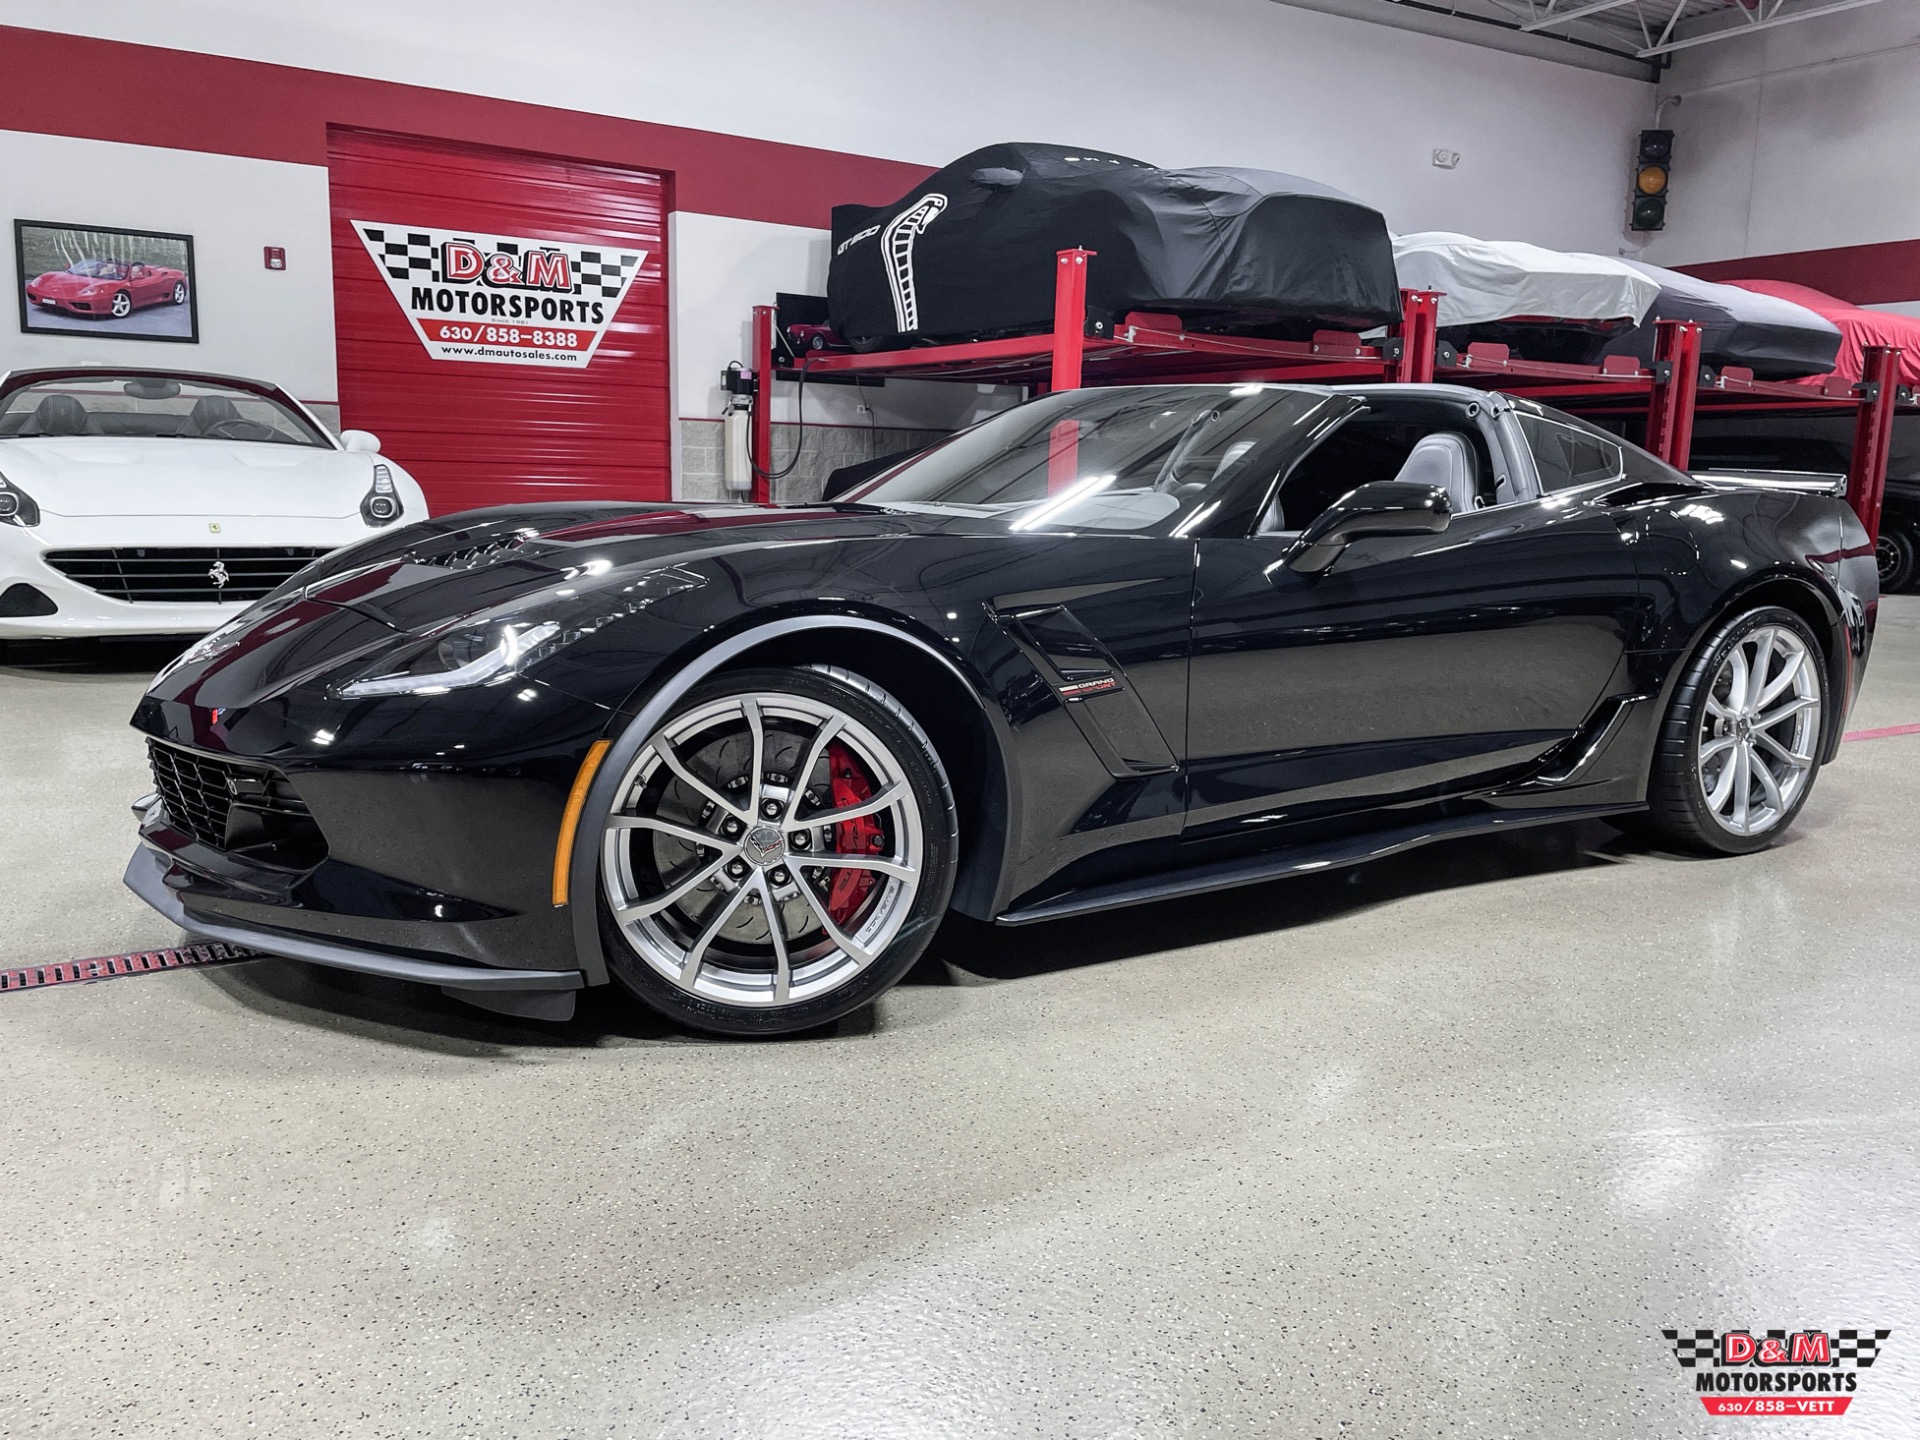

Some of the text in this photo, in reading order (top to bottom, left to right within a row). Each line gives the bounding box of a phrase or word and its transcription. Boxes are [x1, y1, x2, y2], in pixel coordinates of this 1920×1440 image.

[442, 241, 574, 293] D&M
[411, 286, 604, 324] MOTORSPORTS
[439, 324, 578, 348] 630/858-8388
[441, 346, 578, 362] www.dmautosales.com
[1078, 677, 1114, 688] GRAND
[1081, 681, 1116, 692] SPORT
